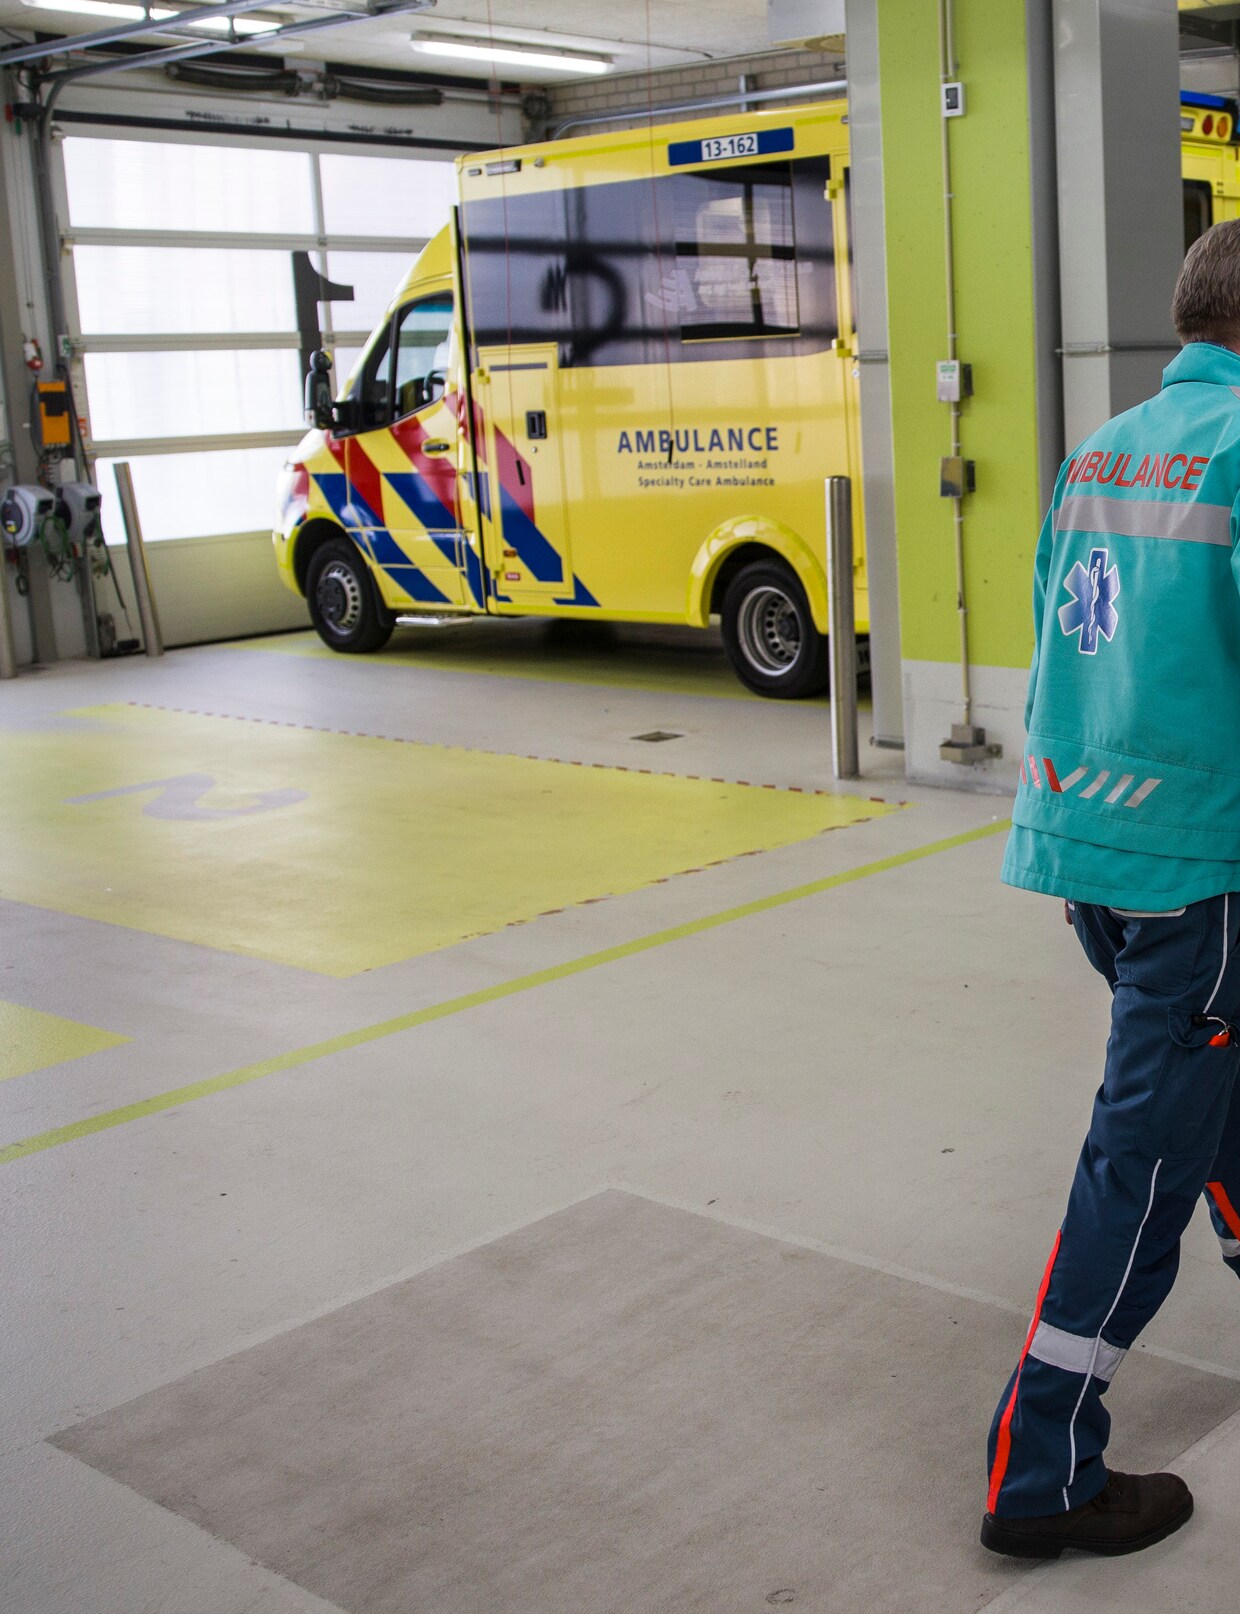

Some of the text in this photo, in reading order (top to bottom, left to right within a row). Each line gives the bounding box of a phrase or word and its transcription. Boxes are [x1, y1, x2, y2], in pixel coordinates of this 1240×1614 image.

[704, 136, 755, 158] 13-162
[617, 427, 779, 453] AMBULANCE
[637, 459, 695, 470] Amsterdam
[706, 458, 768, 469] Amstelland
[1066, 450, 1211, 490] MBULANCE
[638, 475, 775, 488] Specialty Care Ambulance
